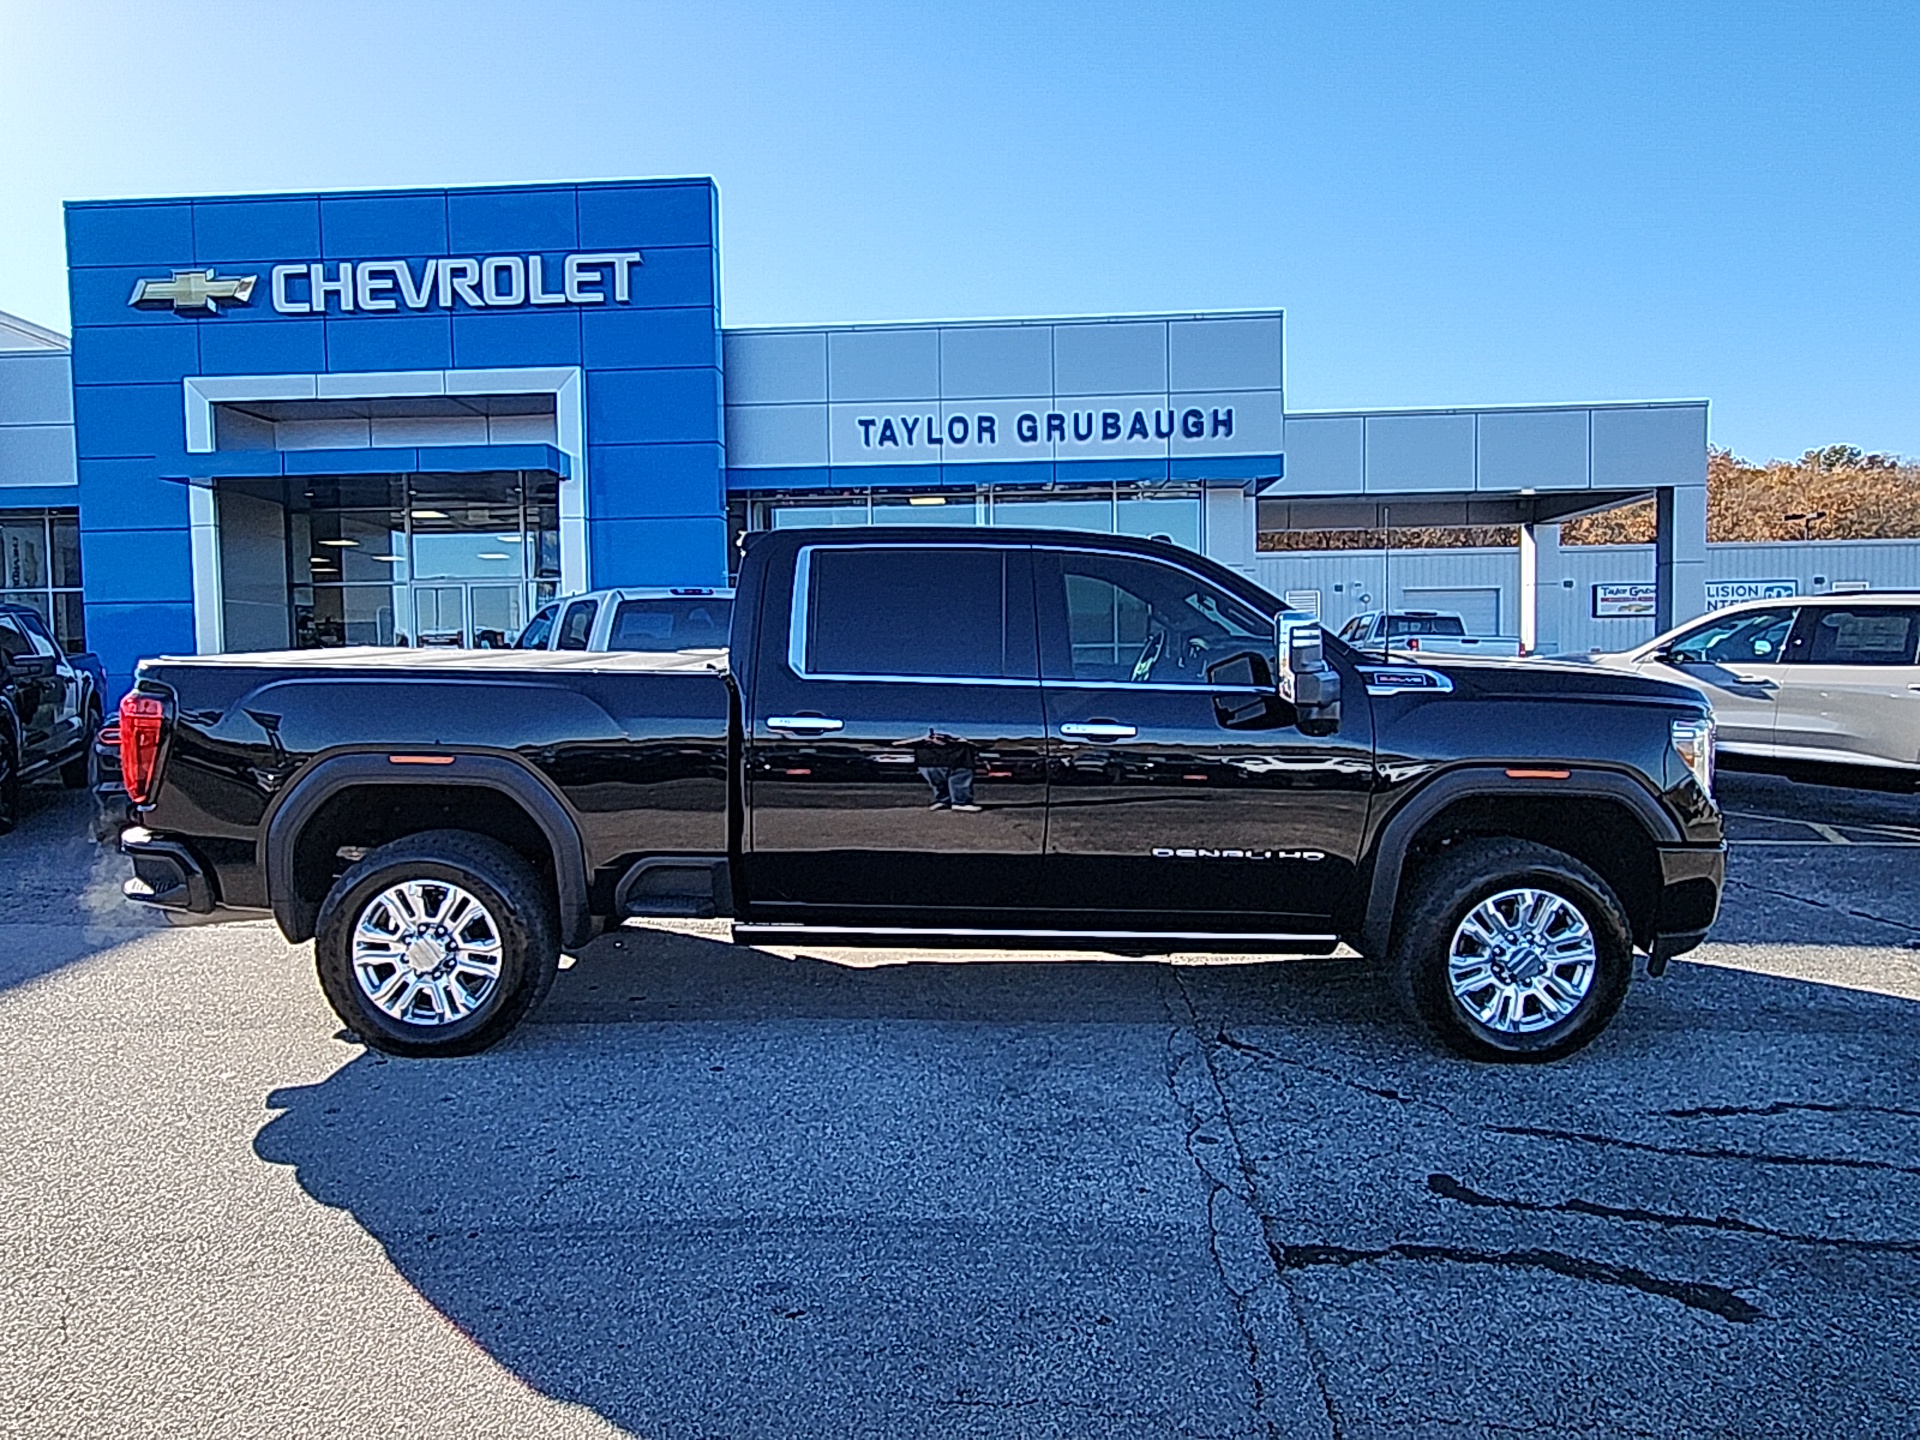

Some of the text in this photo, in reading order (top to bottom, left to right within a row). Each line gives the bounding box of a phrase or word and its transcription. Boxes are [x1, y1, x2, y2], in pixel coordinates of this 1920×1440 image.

[271, 251, 643, 314] CHEVROLET
[857, 408, 1234, 448] TAYLOR GRUBAUGH
